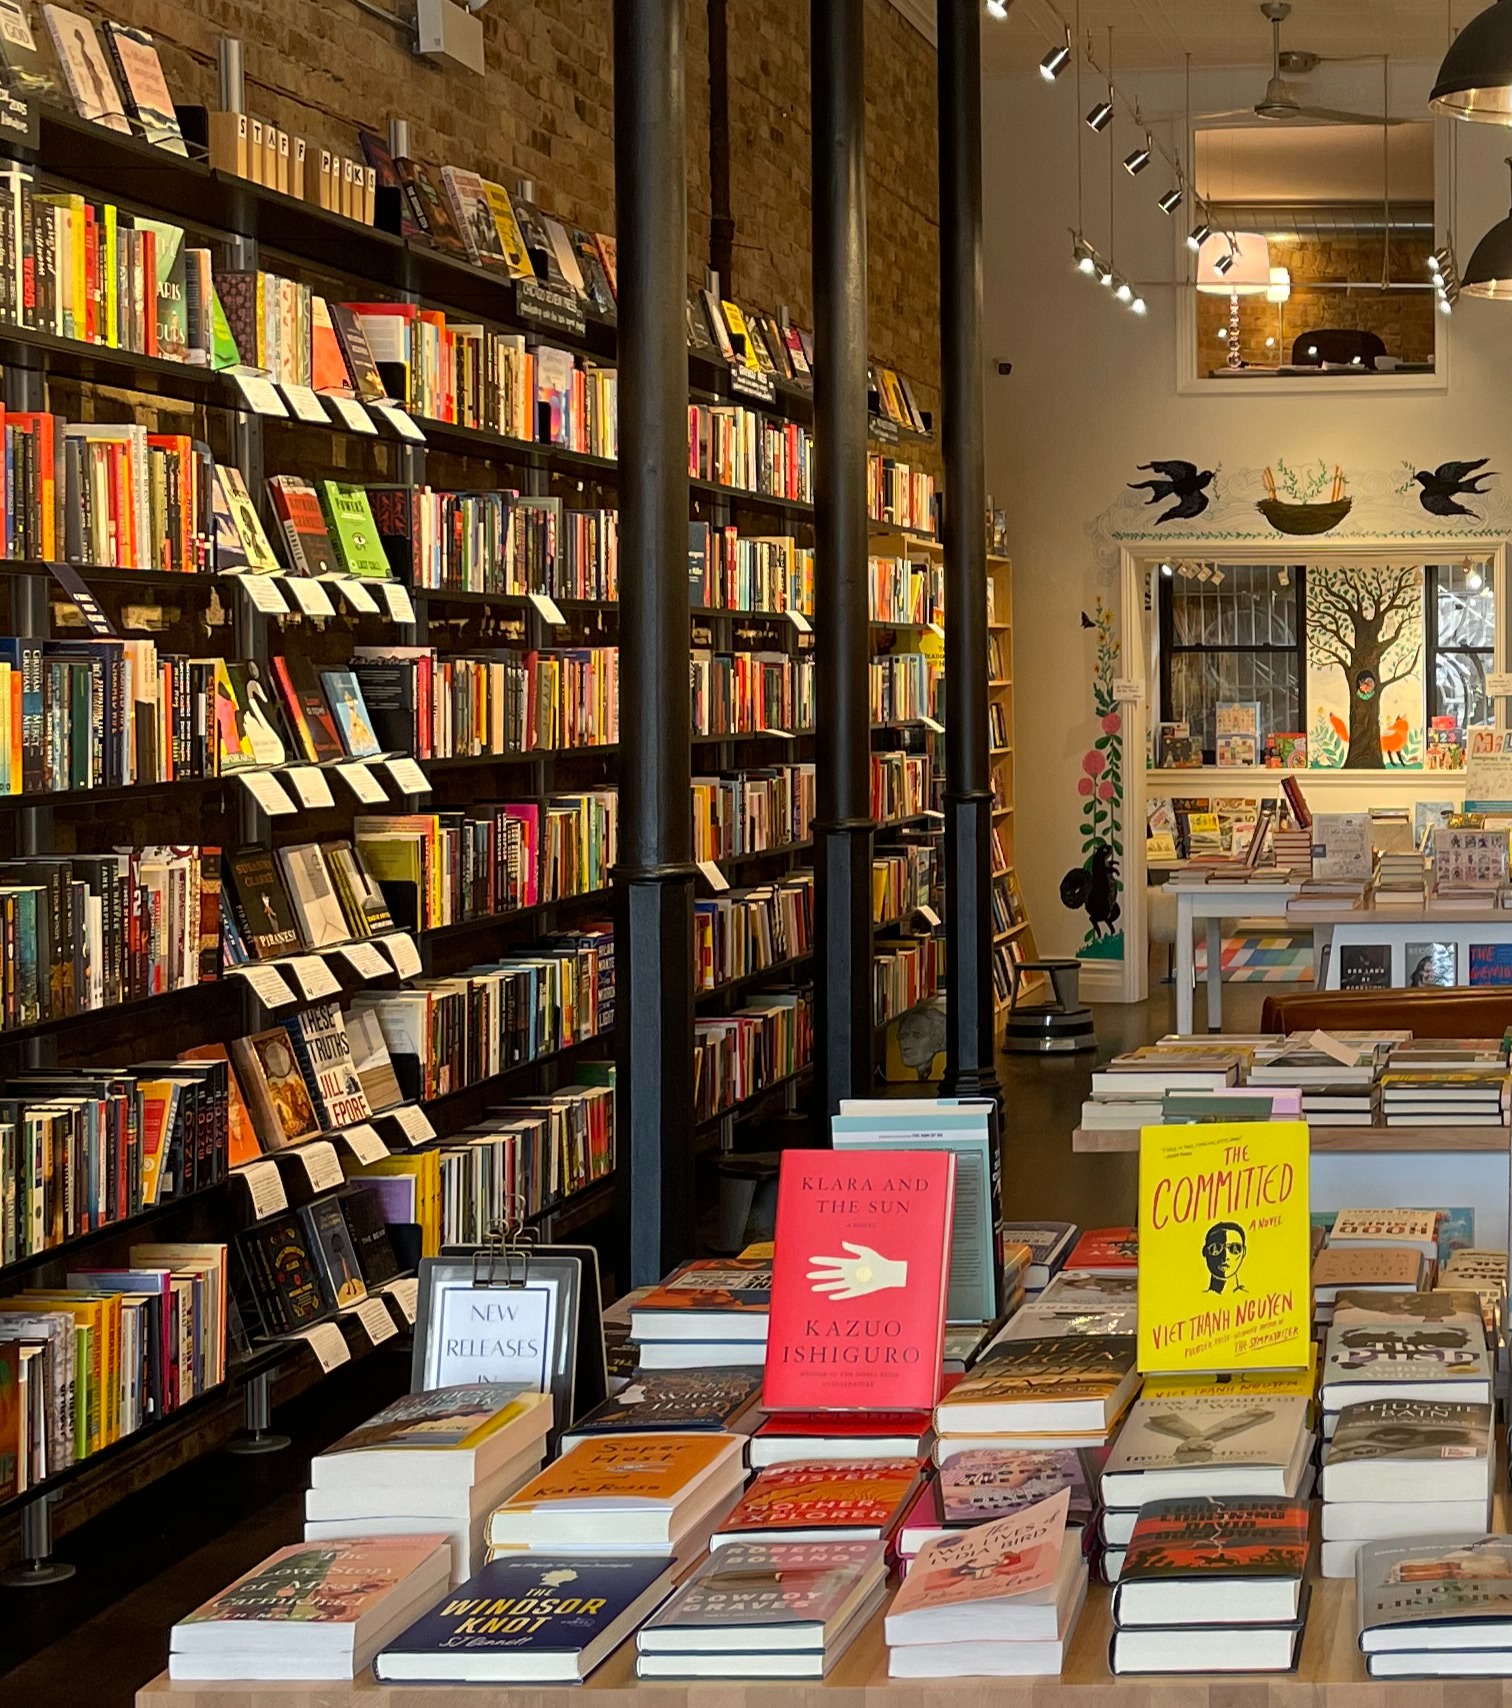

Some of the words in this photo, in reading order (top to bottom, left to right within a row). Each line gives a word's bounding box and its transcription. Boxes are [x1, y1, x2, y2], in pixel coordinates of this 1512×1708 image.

[239, 118, 304, 159] STAFF
[335, 498, 365, 513] POWERS
[236, 859, 272, 874] SUSANNA
[260, 930, 297, 948] PIRANESI
[1470, 947, 1492, 961] THE
[301, 1004, 335, 1035] THESE
[305, 1032, 350, 1064] TRUTHS
[1224, 1145, 1250, 1165] THE
[801, 1177, 873, 1192] KLARA
[883, 1177, 930, 1192] AND
[1153, 1163, 1293, 1230] COMMITTED
[818, 1200, 859, 1214] THE
[867, 1200, 911, 1214] SUN
[1249, 1219, 1257, 1230] A
[1258, 1215, 1283, 1228] NOVEL
[471, 1304, 518, 1321] NEW
[1152, 1324, 1183, 1350] VIET
[1188, 1309, 1232, 1338] THANH
[1235, 1291, 1293, 1327] NGUYEN
[805, 1320, 902, 1337] KAZUO
[446, 1339, 538, 1357] RELEASES
[782, 1346, 920, 1365] ISHIGURO
[1382, 1410, 1449, 1418] BAIN
[595, 1441, 694, 1454] Super
[591, 1453, 675, 1465] Host
[533, 1484, 592, 1496] Kate
[596, 1483, 662, 1494] Russo
[727, 1510, 889, 1524] EXPLORER
[318, 1551, 369, 1560] The
[727, 1544, 868, 1556] ROBERTO
[929, 1544, 973, 1558] TWO
[931, 1548, 990, 1565] LYDIA
[329, 1567, 394, 1576] Story
[240, 1580, 277, 1592] of
[525, 1589, 557, 1597] THE
[210, 1597, 368, 1607] Carmichael
[684, 1591, 824, 1604] COWBOY
[440, 1599, 607, 1616] WINDSOR
[682, 1599, 810, 1612] GRAVES
[454, 1617, 553, 1634] KNOT
